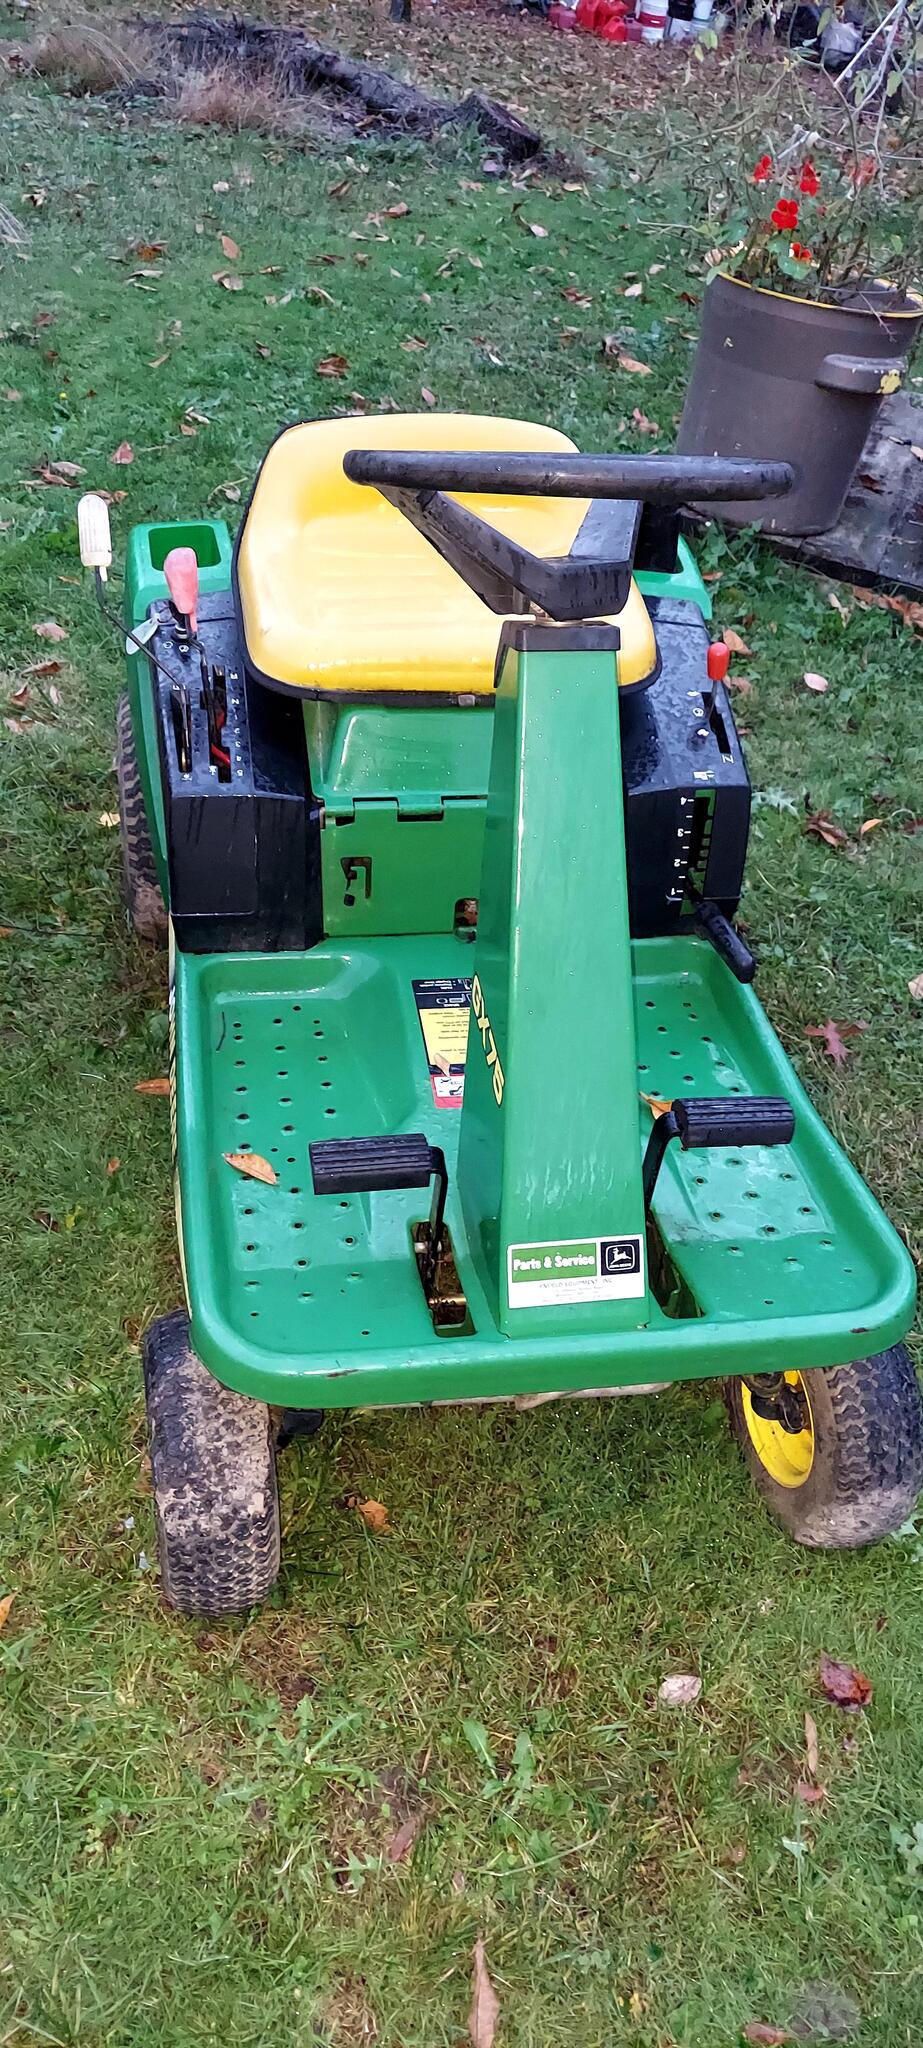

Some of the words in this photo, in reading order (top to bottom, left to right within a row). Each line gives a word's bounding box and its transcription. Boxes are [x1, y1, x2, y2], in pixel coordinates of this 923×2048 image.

[680, 797, 688, 806] 4
[677, 828, 684, 837] 3
[674, 858, 681, 867] 2
[670, 887, 676, 896] 1
[513, 1259, 542, 1271] Parts
[543, 1256, 553, 1269] &
[554, 1254, 595, 1268] Service
